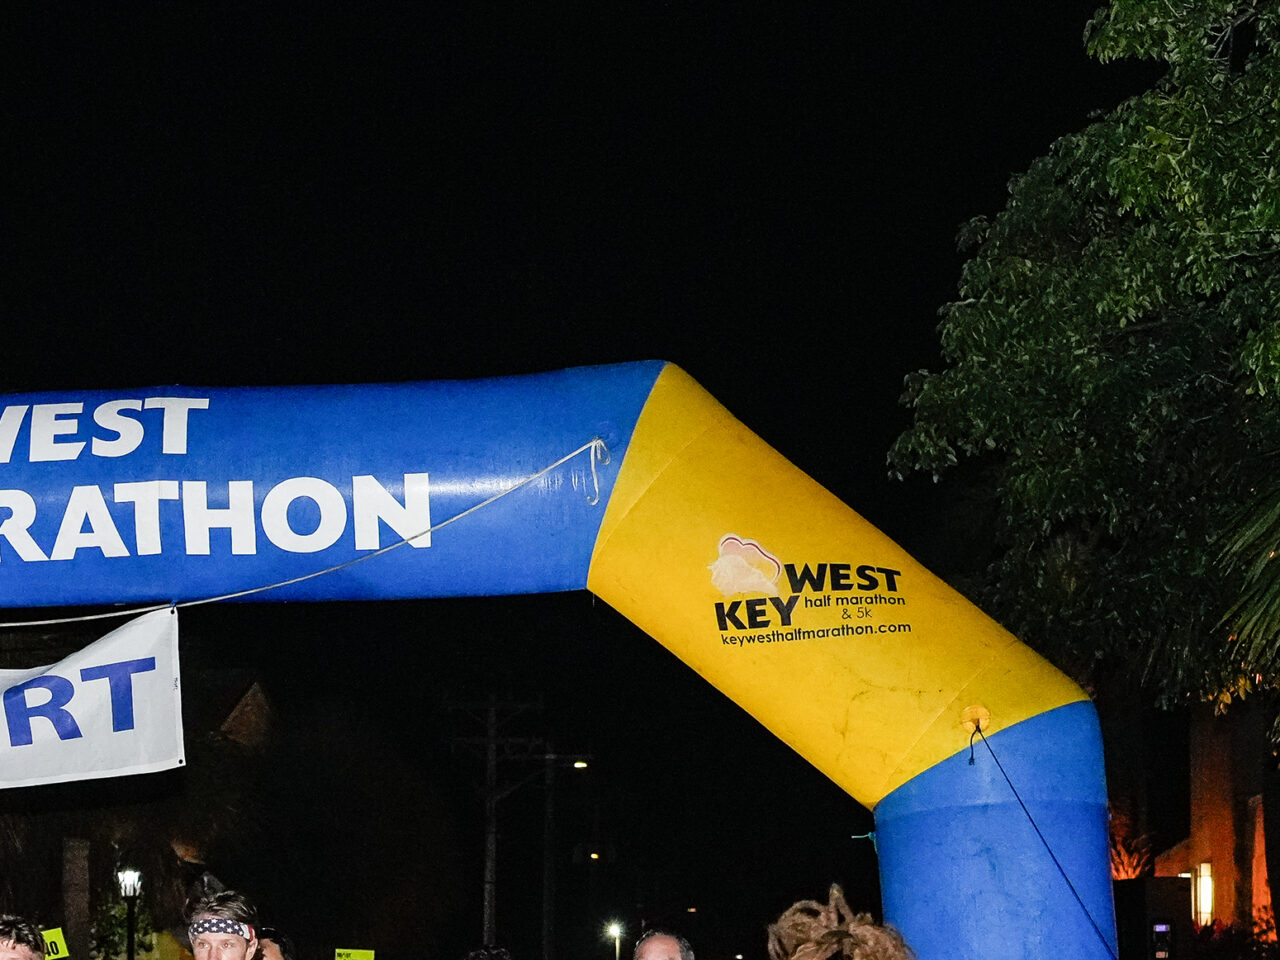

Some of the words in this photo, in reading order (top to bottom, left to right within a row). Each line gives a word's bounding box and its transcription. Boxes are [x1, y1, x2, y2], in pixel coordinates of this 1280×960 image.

[784, 563, 901, 594] WEST
[715, 595, 800, 631] KEY
[805, 595, 831, 608] half
[836, 593, 905, 606] marathon
[842, 608, 852, 619] &
[857, 607, 872, 618] 5k
[721, 622, 911, 647] keywesthalfmarathon.com
